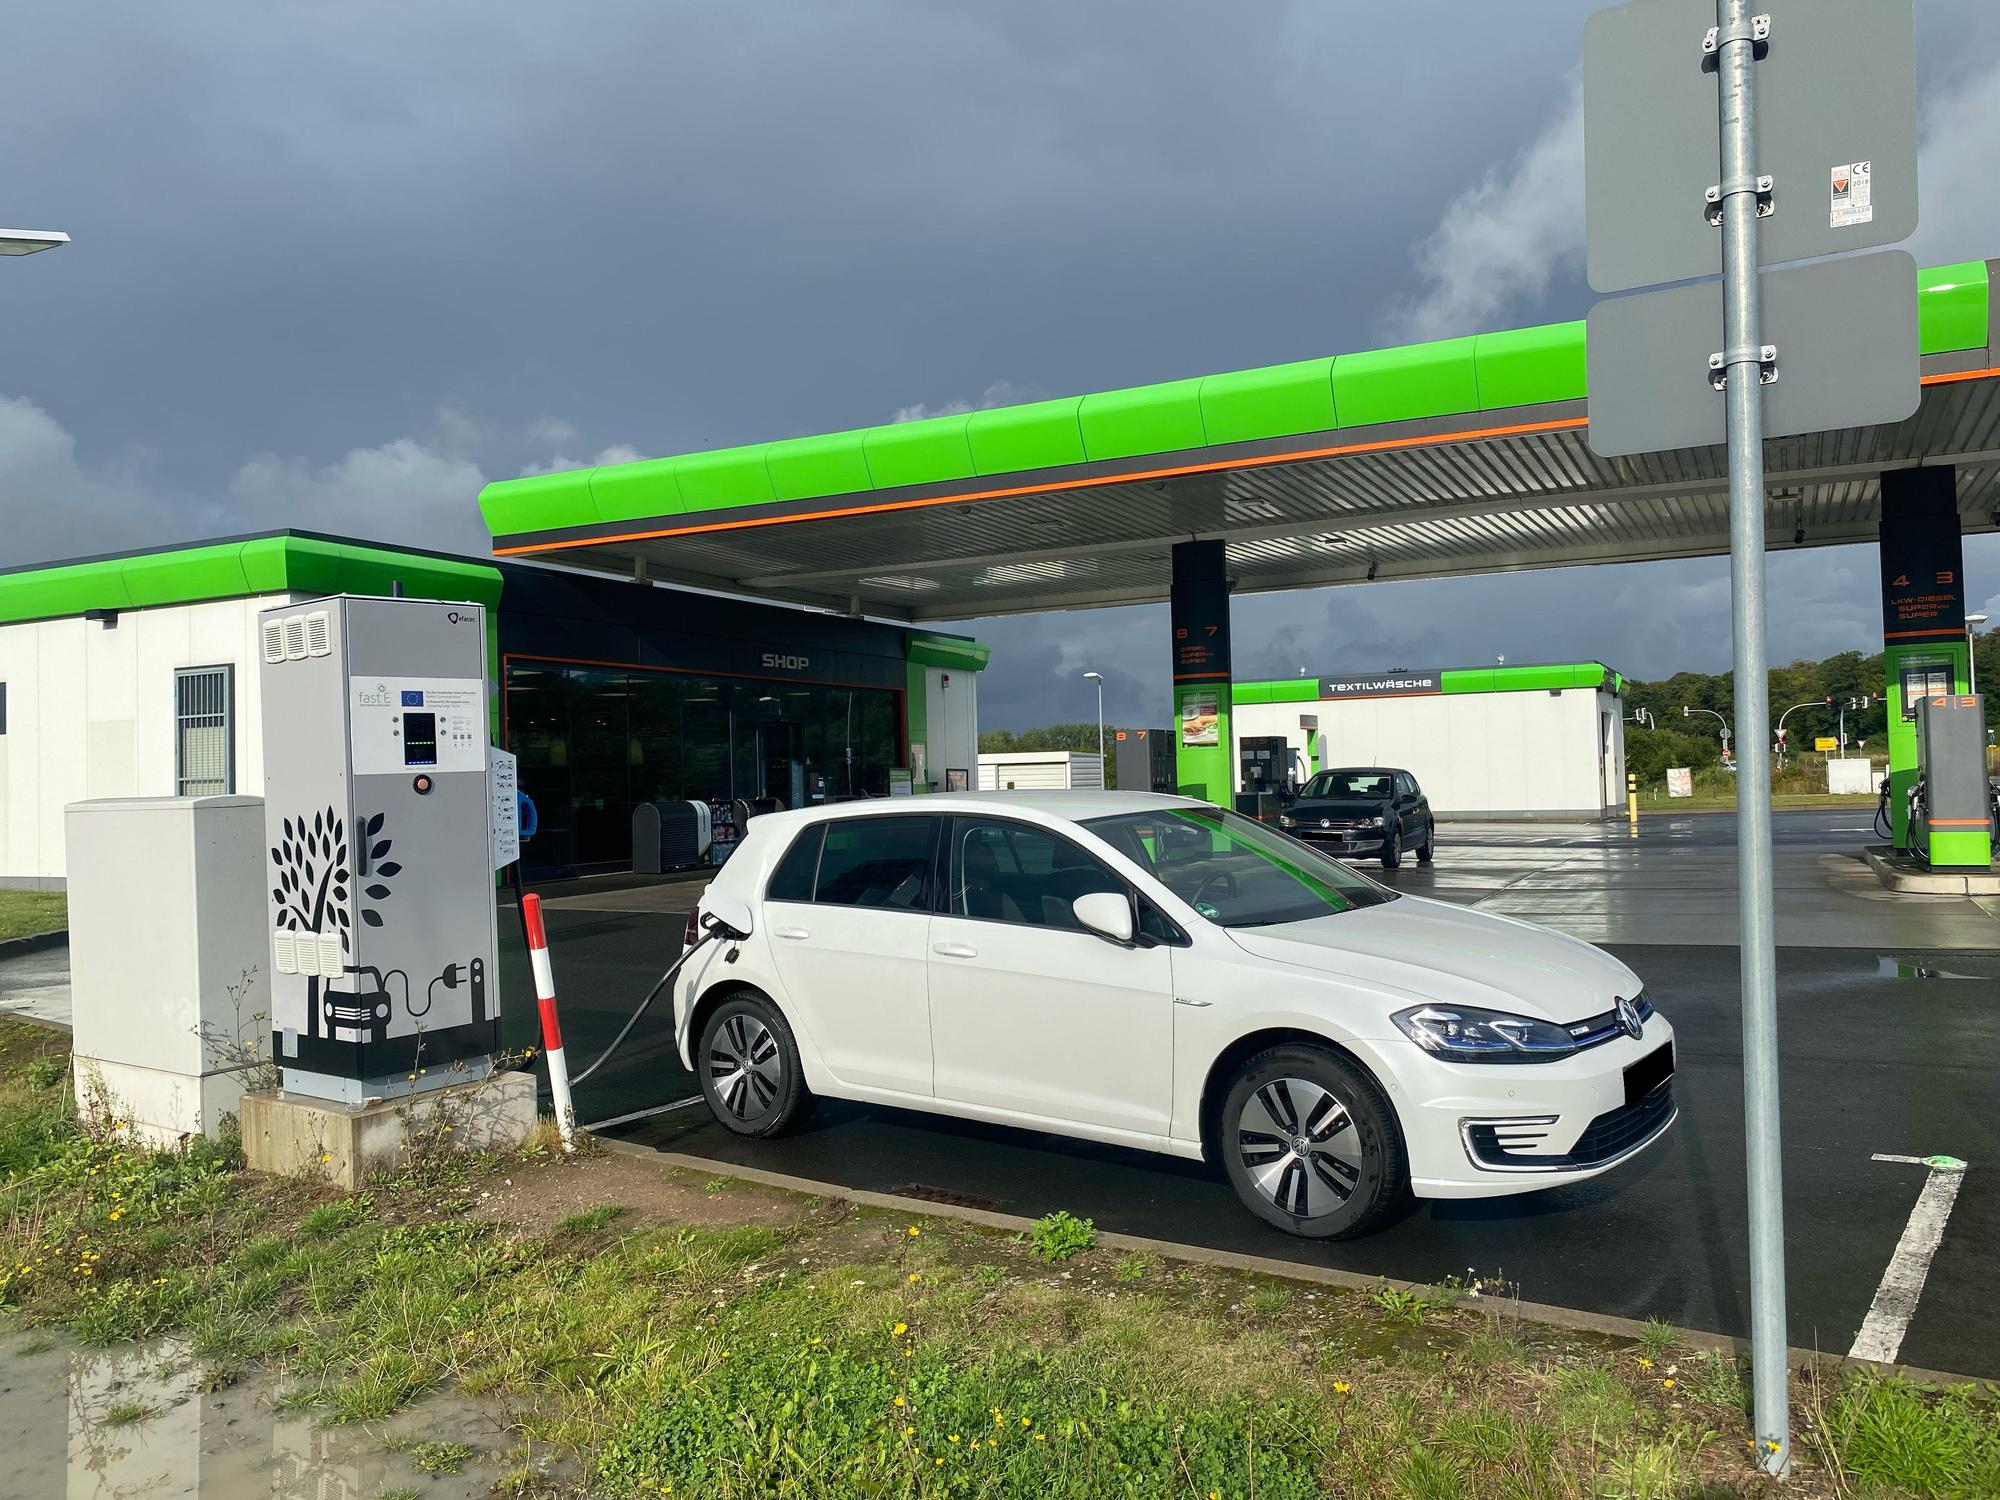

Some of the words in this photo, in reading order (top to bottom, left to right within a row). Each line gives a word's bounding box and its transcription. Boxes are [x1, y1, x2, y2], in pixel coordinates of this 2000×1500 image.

[1892, 575, 1910, 587] 4
[1936, 571, 1953, 584] 3
[1898, 611, 1938, 620] SUPER
[1176, 628, 1188, 639] 8
[1204, 626, 1218, 637] 7
[762, 653, 809, 670] SHOP
[1931, 697, 1947, 707] 4
[1961, 697, 1976, 707] 3
[1116, 732, 1126, 741] 8
[1137, 731, 1146, 740] 7
